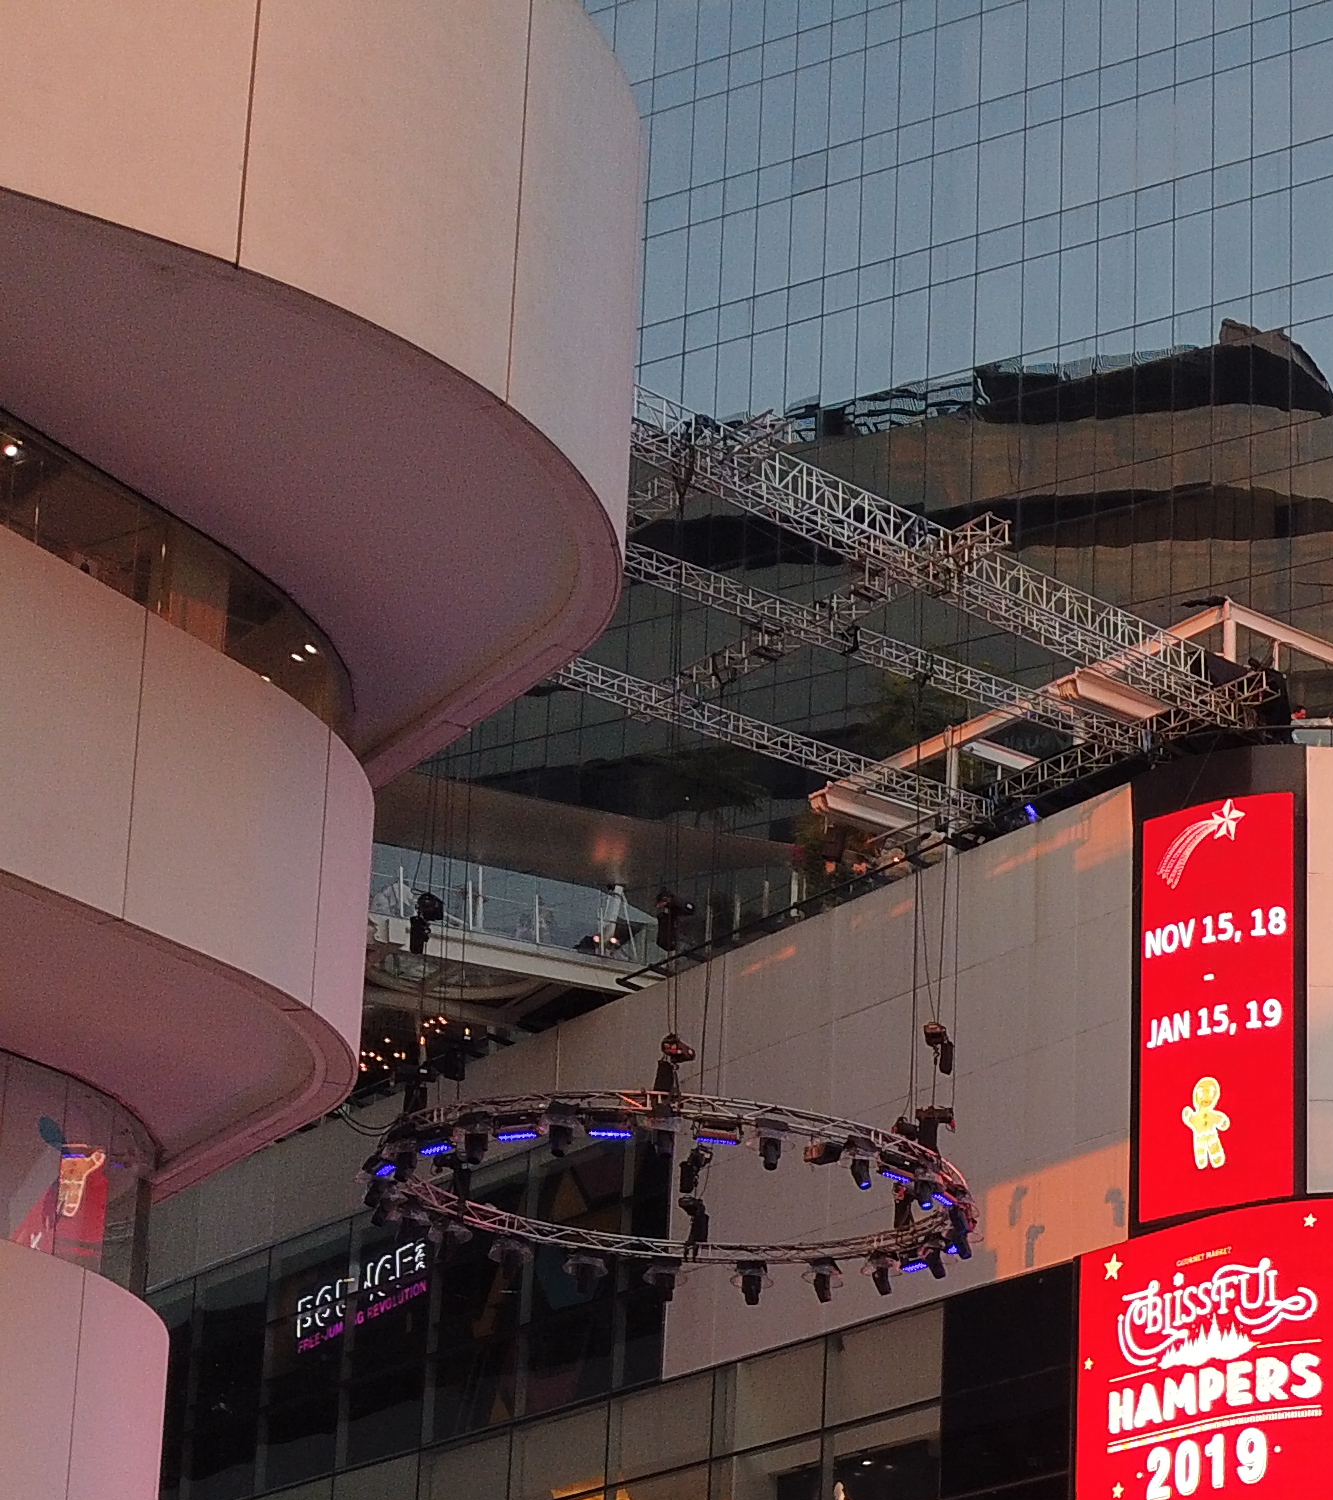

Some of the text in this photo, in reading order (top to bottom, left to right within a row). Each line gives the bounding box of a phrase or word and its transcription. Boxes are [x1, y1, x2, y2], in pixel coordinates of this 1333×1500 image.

[1145, 906, 1287, 958] NOV 15, 18
[1147, 999, 1283, 1049] JAN 15, 19
[366, 1280, 428, 1320] REVOLUTION
[1108, 1352, 1322, 1434] HAMPERS
